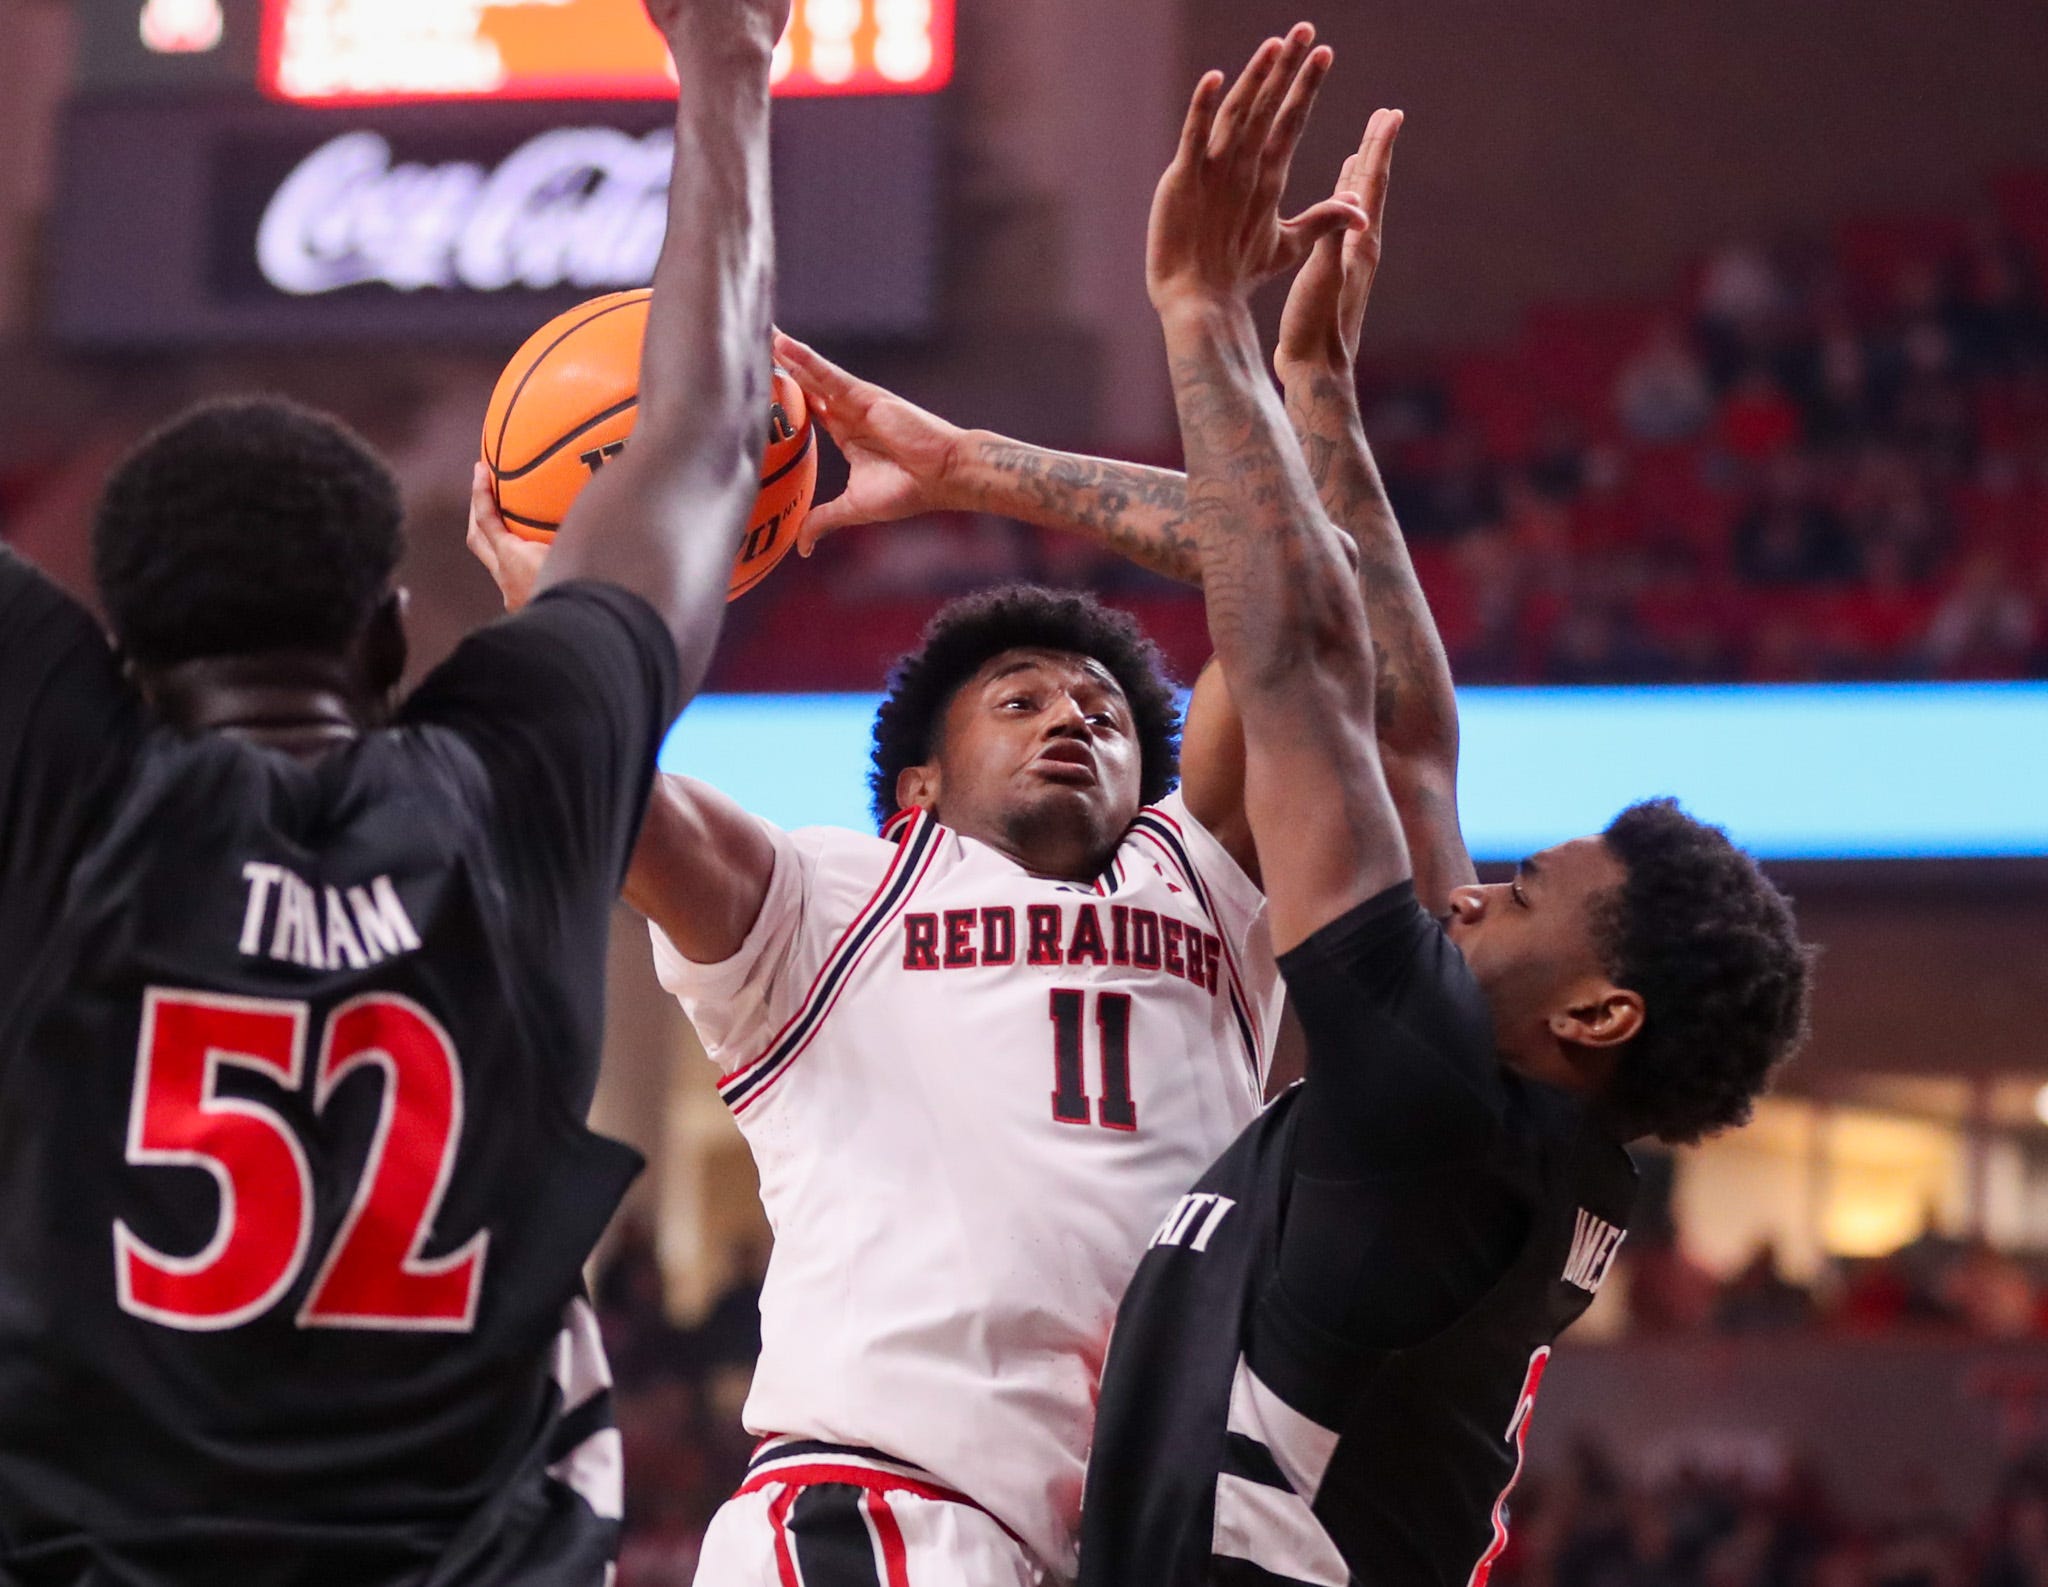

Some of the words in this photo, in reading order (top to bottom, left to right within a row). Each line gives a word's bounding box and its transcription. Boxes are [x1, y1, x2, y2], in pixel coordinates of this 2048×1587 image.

[903, 905, 1015, 970] RED
[1027, 904, 1221, 997] RAIDERS
[1049, 987, 1137, 1131] 11
[113, 985, 490, 1332] 52
